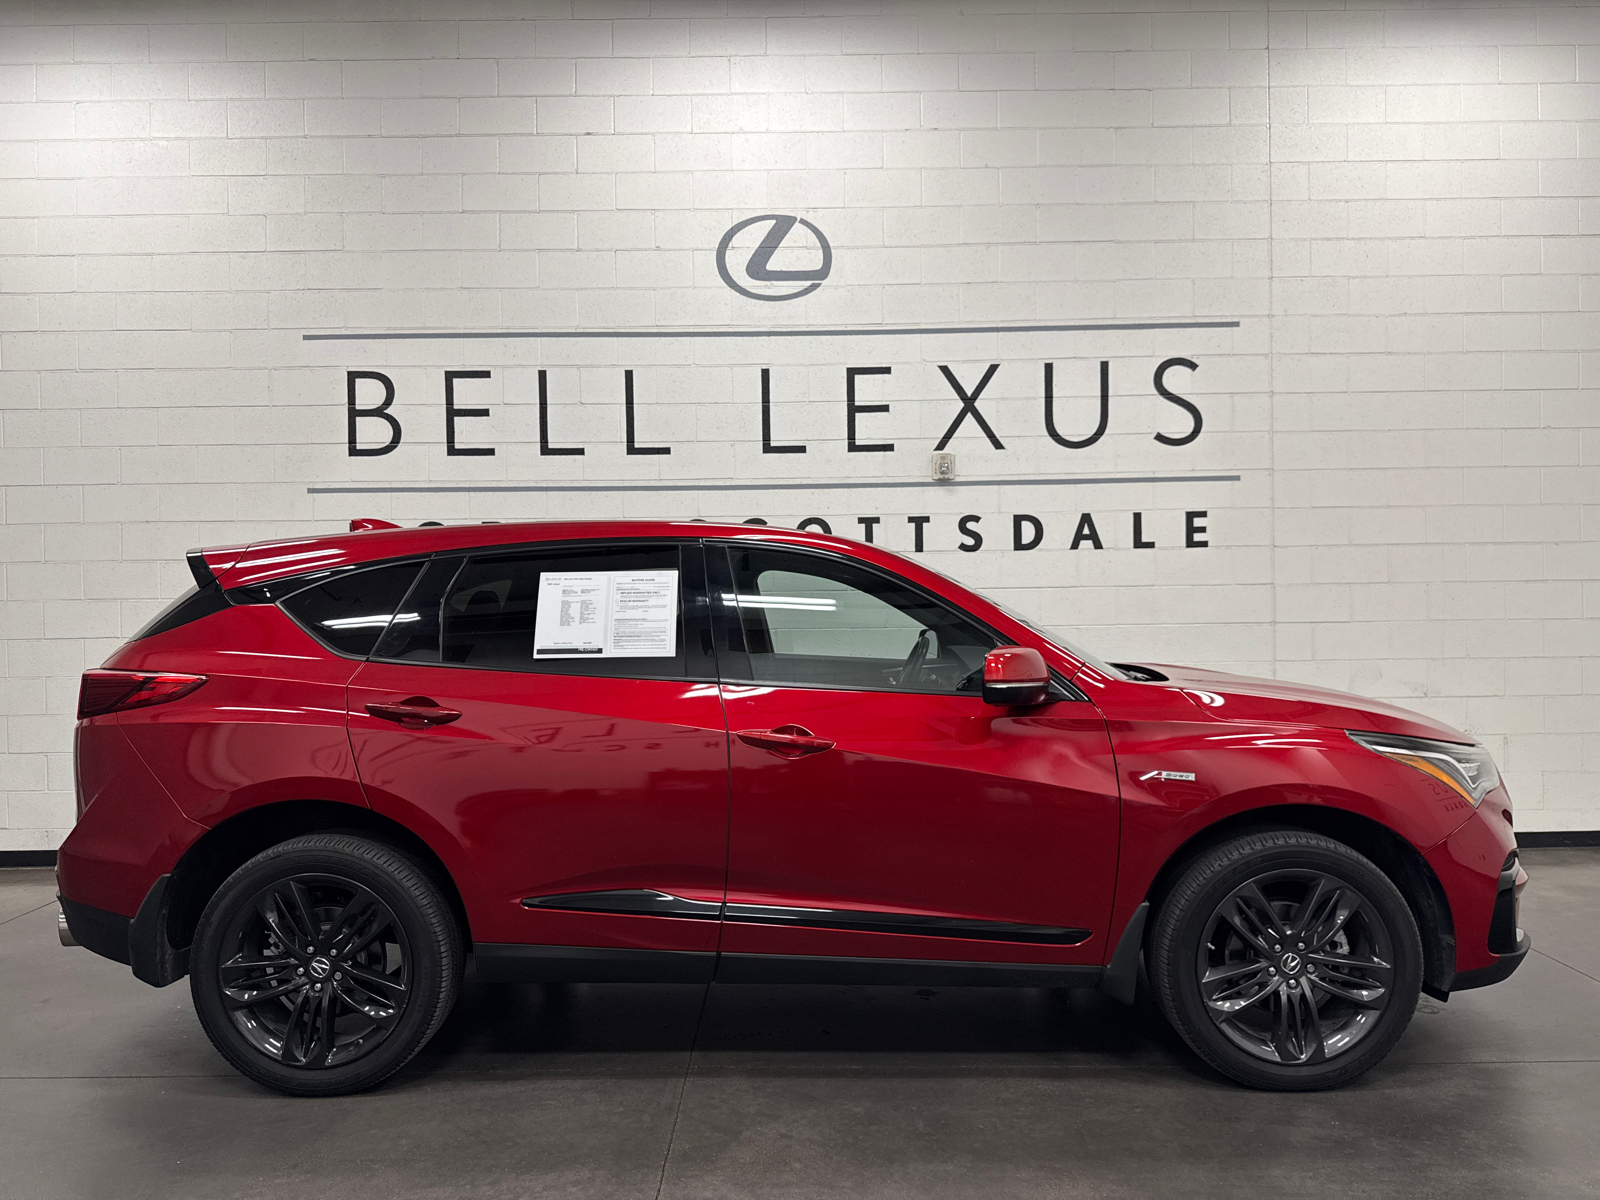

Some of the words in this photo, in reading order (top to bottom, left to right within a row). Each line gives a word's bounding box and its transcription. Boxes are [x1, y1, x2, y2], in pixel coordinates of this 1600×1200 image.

[346, 369, 672, 457] BELL
[760, 356, 1204, 454] LEXUS
[690, 510, 1210, 553] TTSDALE
